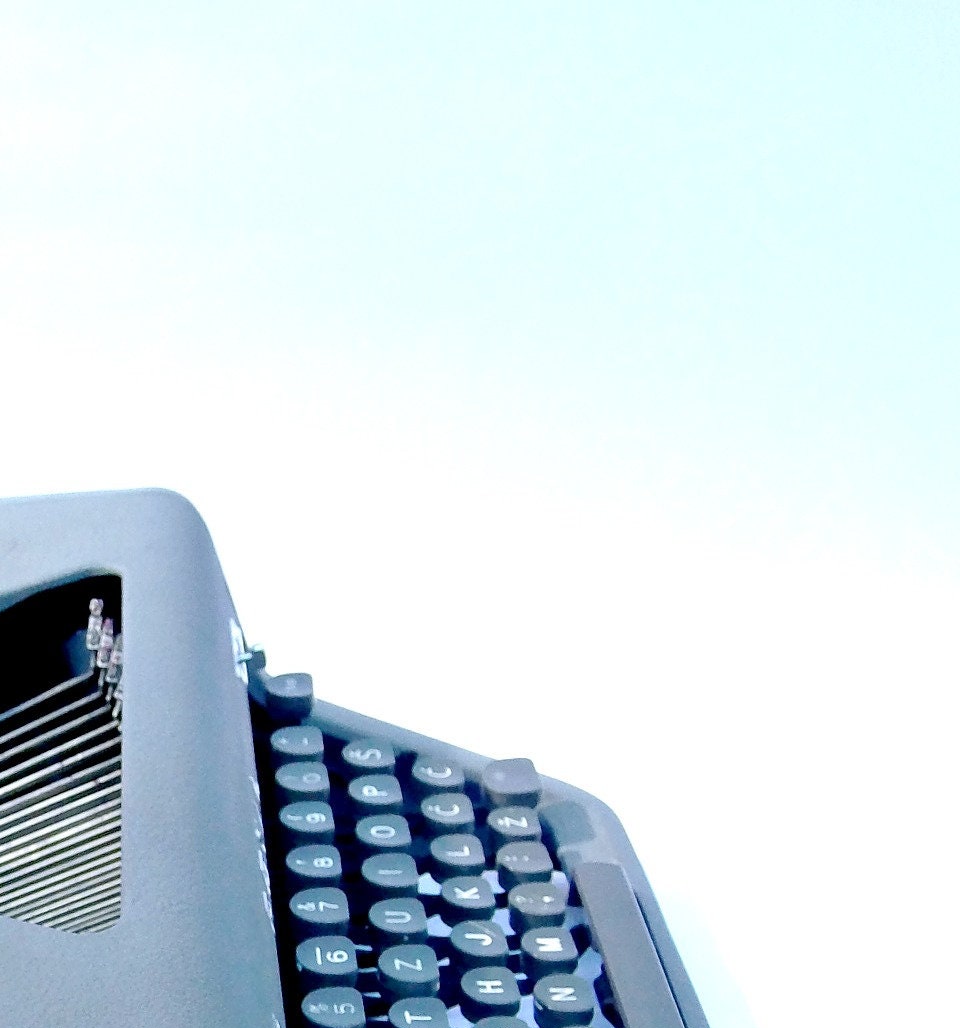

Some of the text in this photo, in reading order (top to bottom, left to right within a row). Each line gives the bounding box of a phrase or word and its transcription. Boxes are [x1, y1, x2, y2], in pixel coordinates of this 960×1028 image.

[362, 786, 387, 797] P
[306, 813, 326, 824] 9
[370, 826, 395, 839] O
[447, 846, 470, 858] L
[313, 857, 333, 868] 8
[455, 887, 480, 899] K
[319, 901, 339, 911] 7
[385, 911, 411, 923] U
[465, 933, 493, 945] J
[536, 938, 563, 951] M
[326, 951, 348, 962] 6
[394, 959, 422, 971] Z
[477, 981, 504, 993] H
[549, 988, 577, 1001] N
[334, 1003, 354, 1014] 5
[404, 1011, 432, 1024] T
